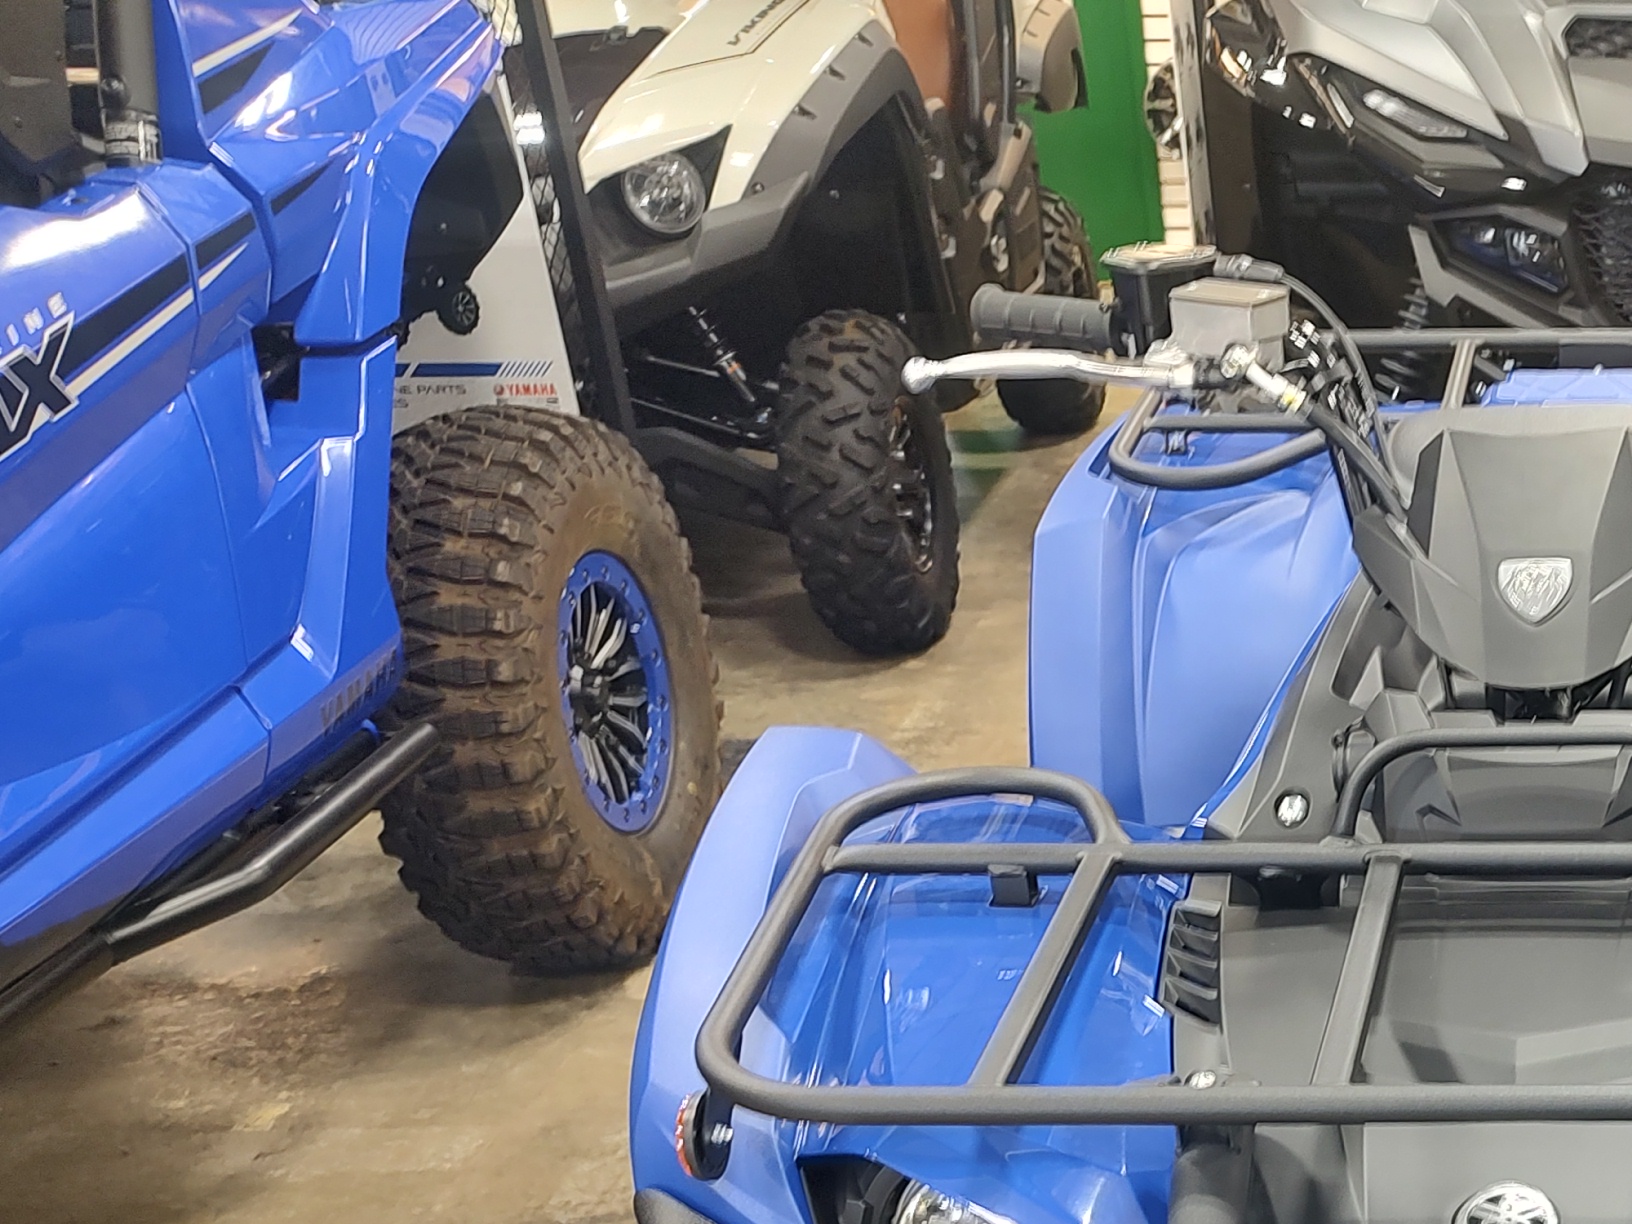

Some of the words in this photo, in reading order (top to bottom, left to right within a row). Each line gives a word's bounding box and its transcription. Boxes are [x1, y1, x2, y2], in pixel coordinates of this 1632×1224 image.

[0, 292, 67, 355] INE
[417, 385, 466, 395] PARTS
[507, 384, 557, 396] YAMAHA
